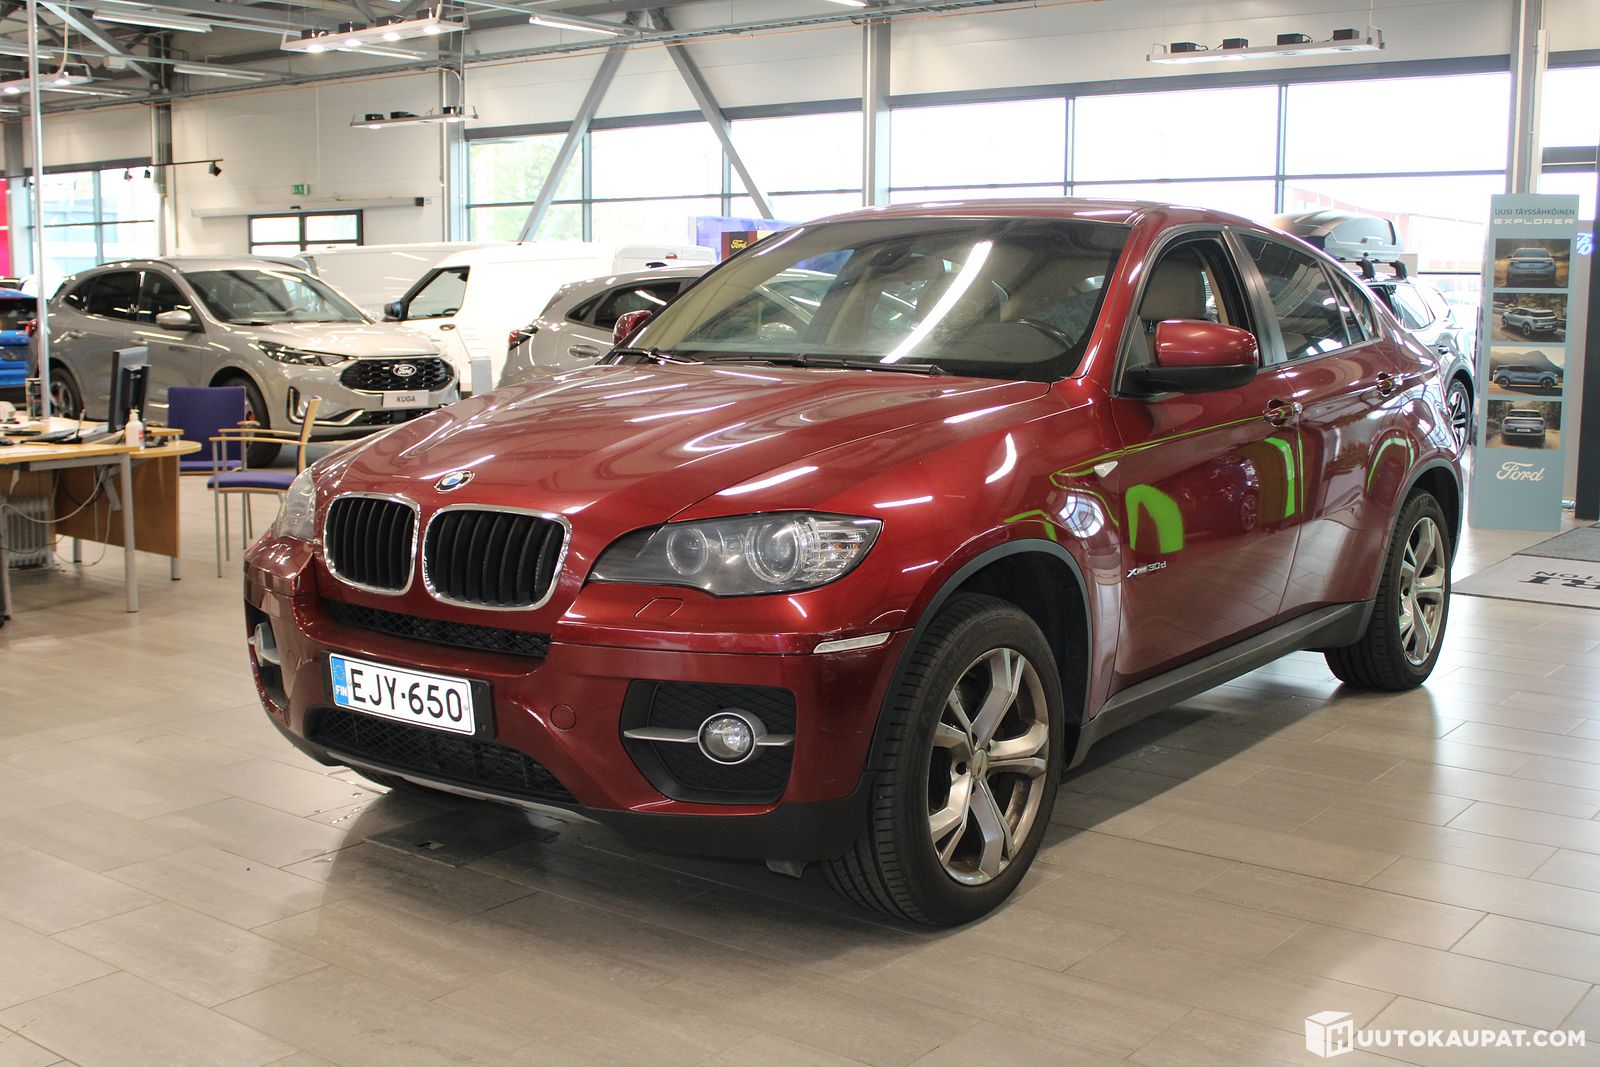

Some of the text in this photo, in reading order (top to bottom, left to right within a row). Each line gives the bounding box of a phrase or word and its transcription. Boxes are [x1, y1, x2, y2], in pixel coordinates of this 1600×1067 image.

[1494, 208, 1575, 216] UUSI TÄYSSÄHKÖINEN
[731, 239, 748, 249] Ford
[1496, 461, 1546, 481] Ford
[336, 685, 348, 697] FIN
[350, 668, 463, 722] EJY-650
